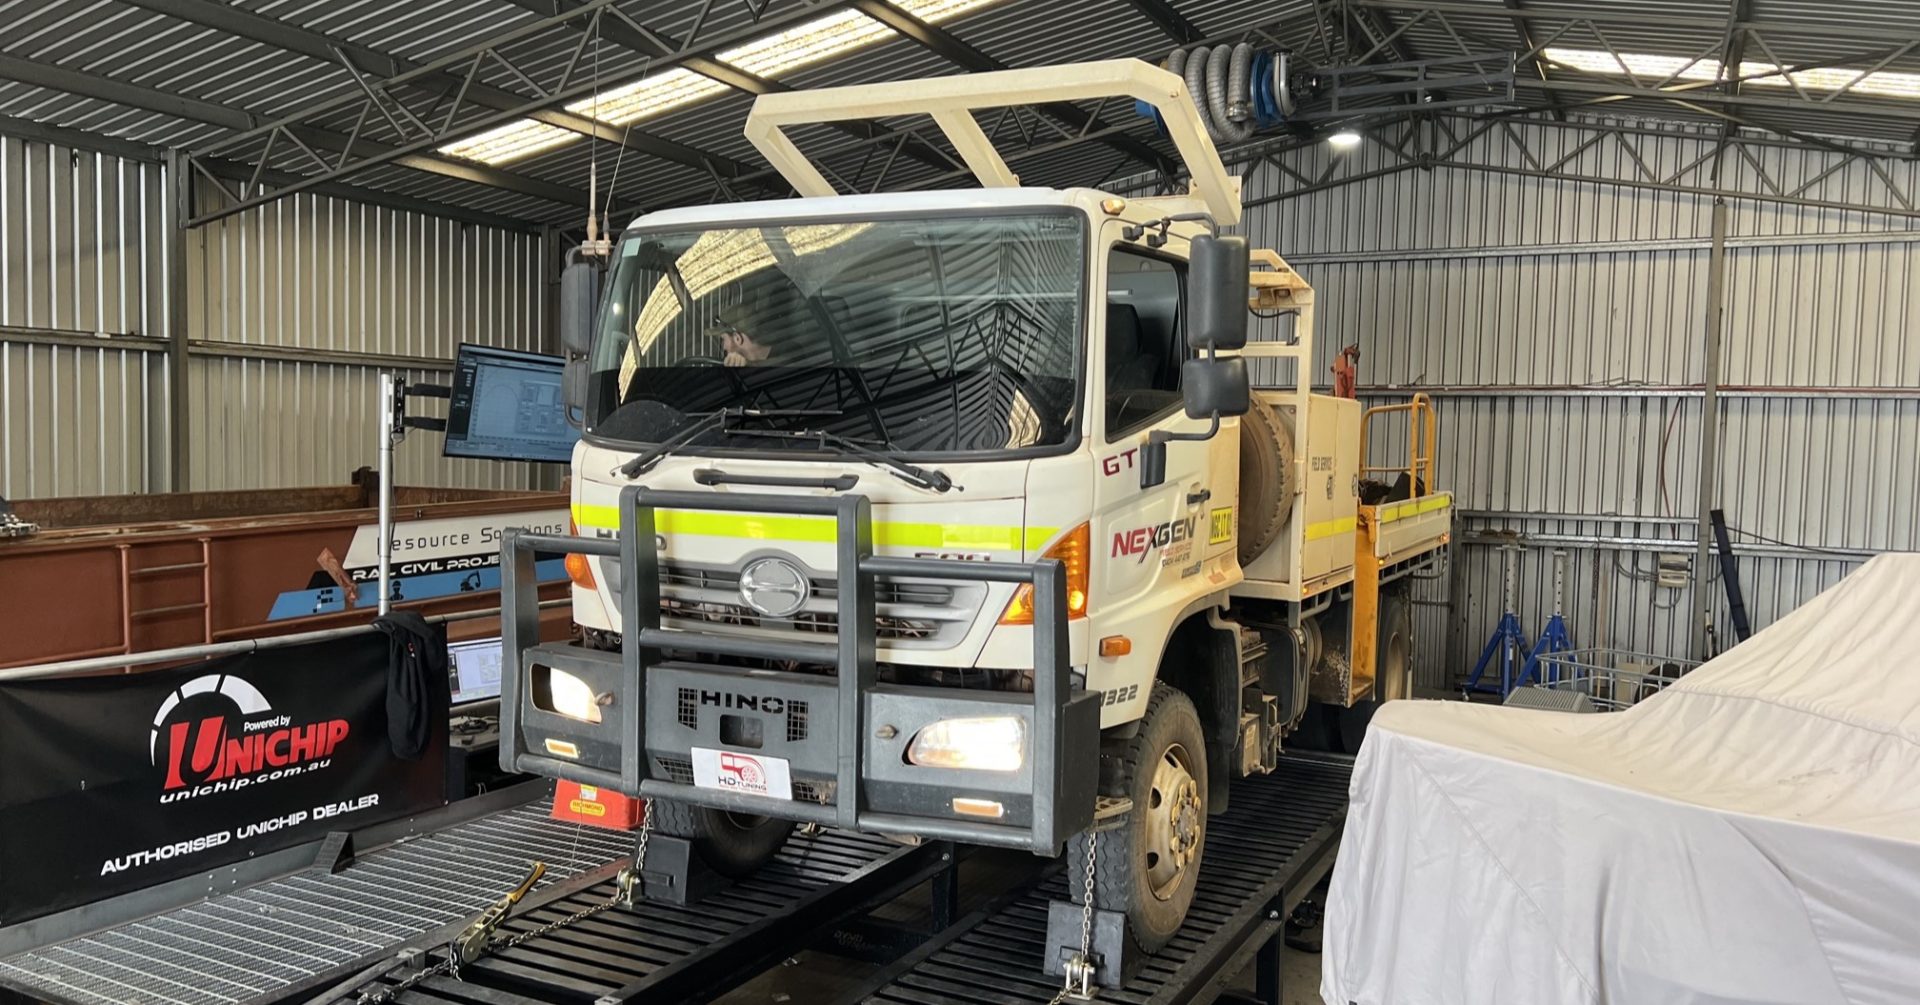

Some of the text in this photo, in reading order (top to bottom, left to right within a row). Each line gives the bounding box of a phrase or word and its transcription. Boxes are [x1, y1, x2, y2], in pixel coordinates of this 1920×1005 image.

[1103, 448, 1138, 476] GT
[378, 533, 470, 556] esource
[1111, 516, 1196, 564] NEXGEN
[401, 561, 444, 575] CIVIL
[447, 554, 499, 571] PROJE
[701, 690, 784, 714] HINO
[243, 715, 291, 732] Powered by
[164, 716, 349, 789] UNICHIP
[160, 759, 331, 804] unichip.com.au
[100, 793, 379, 876] AUTHORISED UNICHIP DEALER
